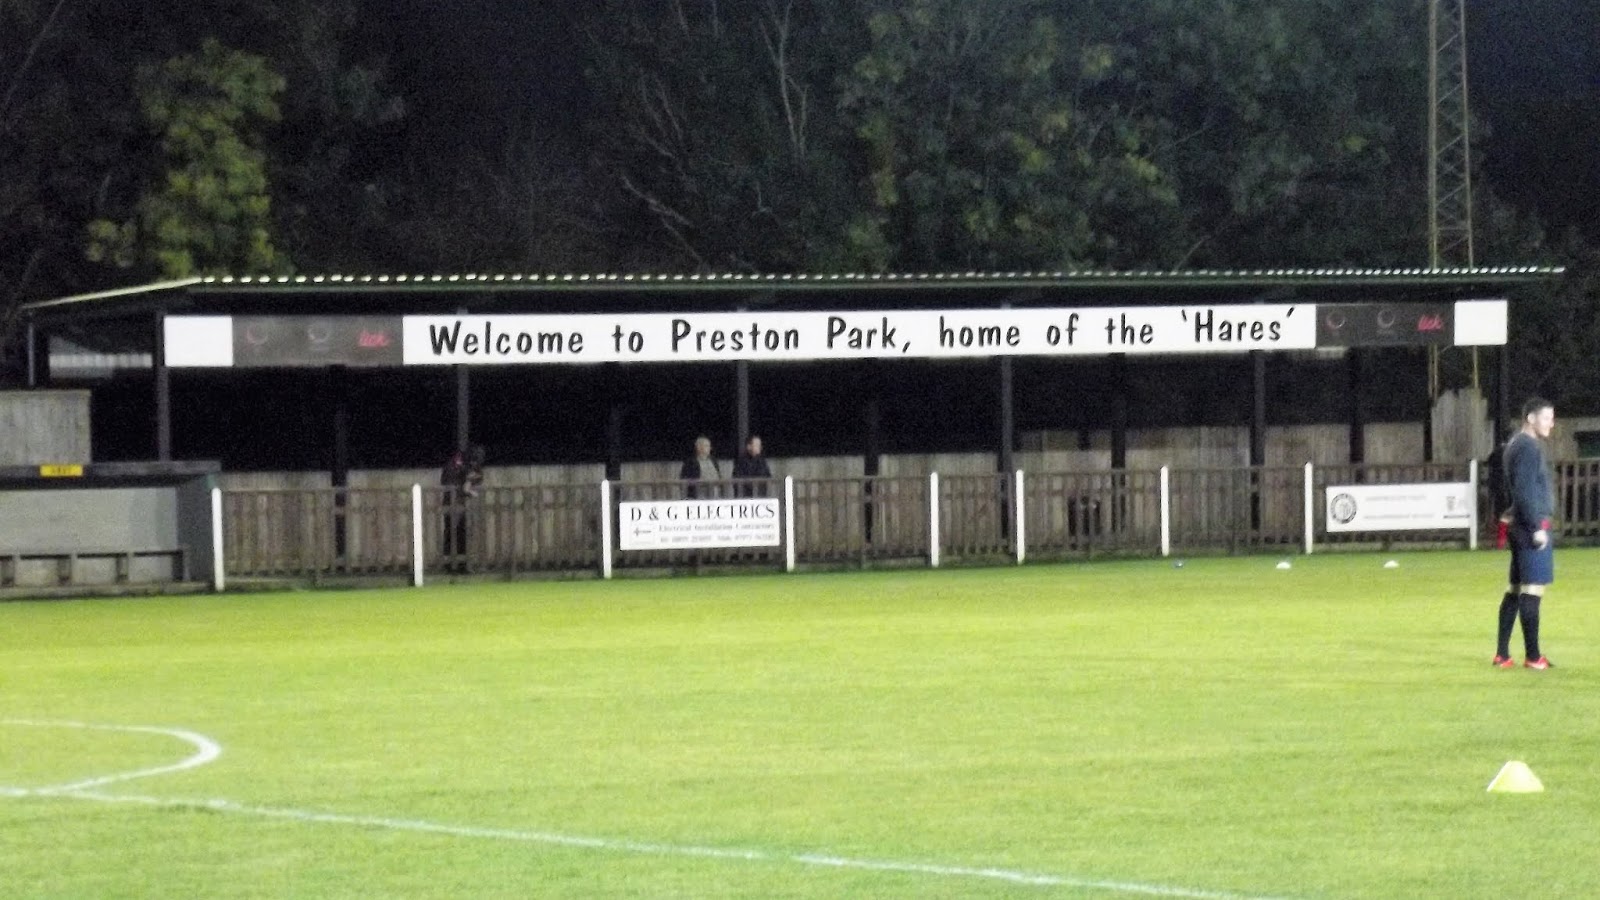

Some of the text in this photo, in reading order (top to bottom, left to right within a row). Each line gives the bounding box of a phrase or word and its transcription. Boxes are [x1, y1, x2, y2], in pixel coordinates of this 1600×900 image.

[429, 320, 583, 356] Welcome
[611, 324, 644, 353] to
[671, 318, 799, 353] Preston
[826, 316, 911, 354] Park,
[939, 315, 1020, 348] home
[1046, 312, 1080, 346] of
[1105, 312, 1153, 345] the
[630, 503, 775, 522] D & G ELECTRICS
